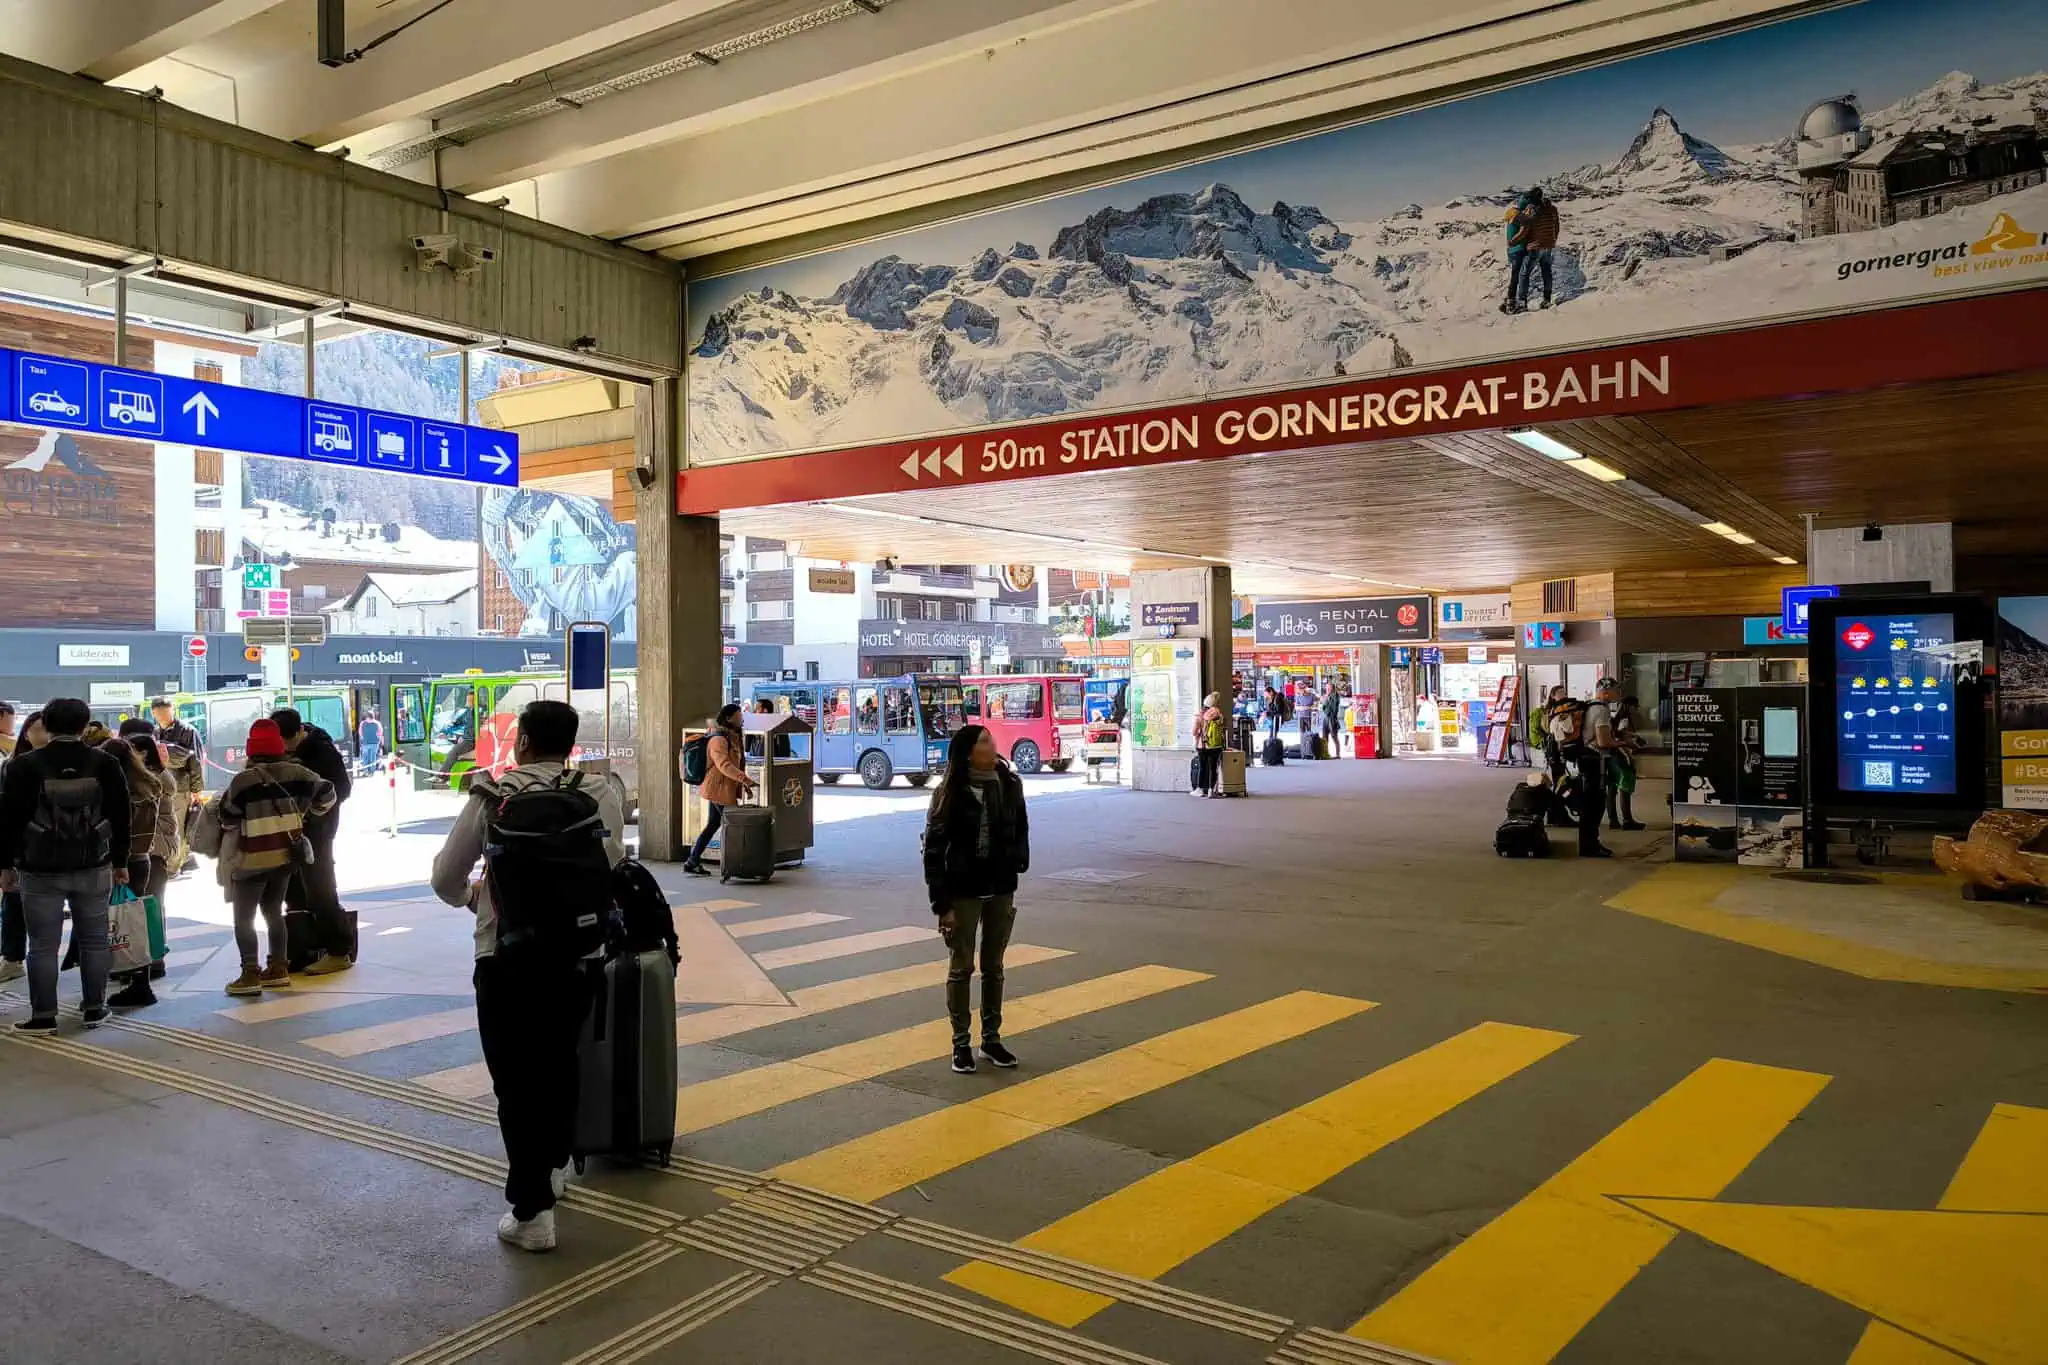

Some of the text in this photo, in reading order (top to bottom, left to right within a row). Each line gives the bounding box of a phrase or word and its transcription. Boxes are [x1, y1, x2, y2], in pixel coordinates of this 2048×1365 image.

[1837, 241, 1968, 280] gornergrat
[1933, 262, 1968, 278] best
[1973, 255, 2014, 272] view
[28, 366, 48, 376] Taxi
[980, 354, 1670, 472] 50m STATION GORNERGRAT-BAHN
[1319, 607, 1389, 621] RENTAL
[1335, 623, 1374, 634] 50m
[861, 633, 894, 646] HOTEL
[903, 632, 931, 646] HOTEL
[1677, 694, 1713, 703] HOTEL
[1677, 704, 1720, 712] PICK UP
